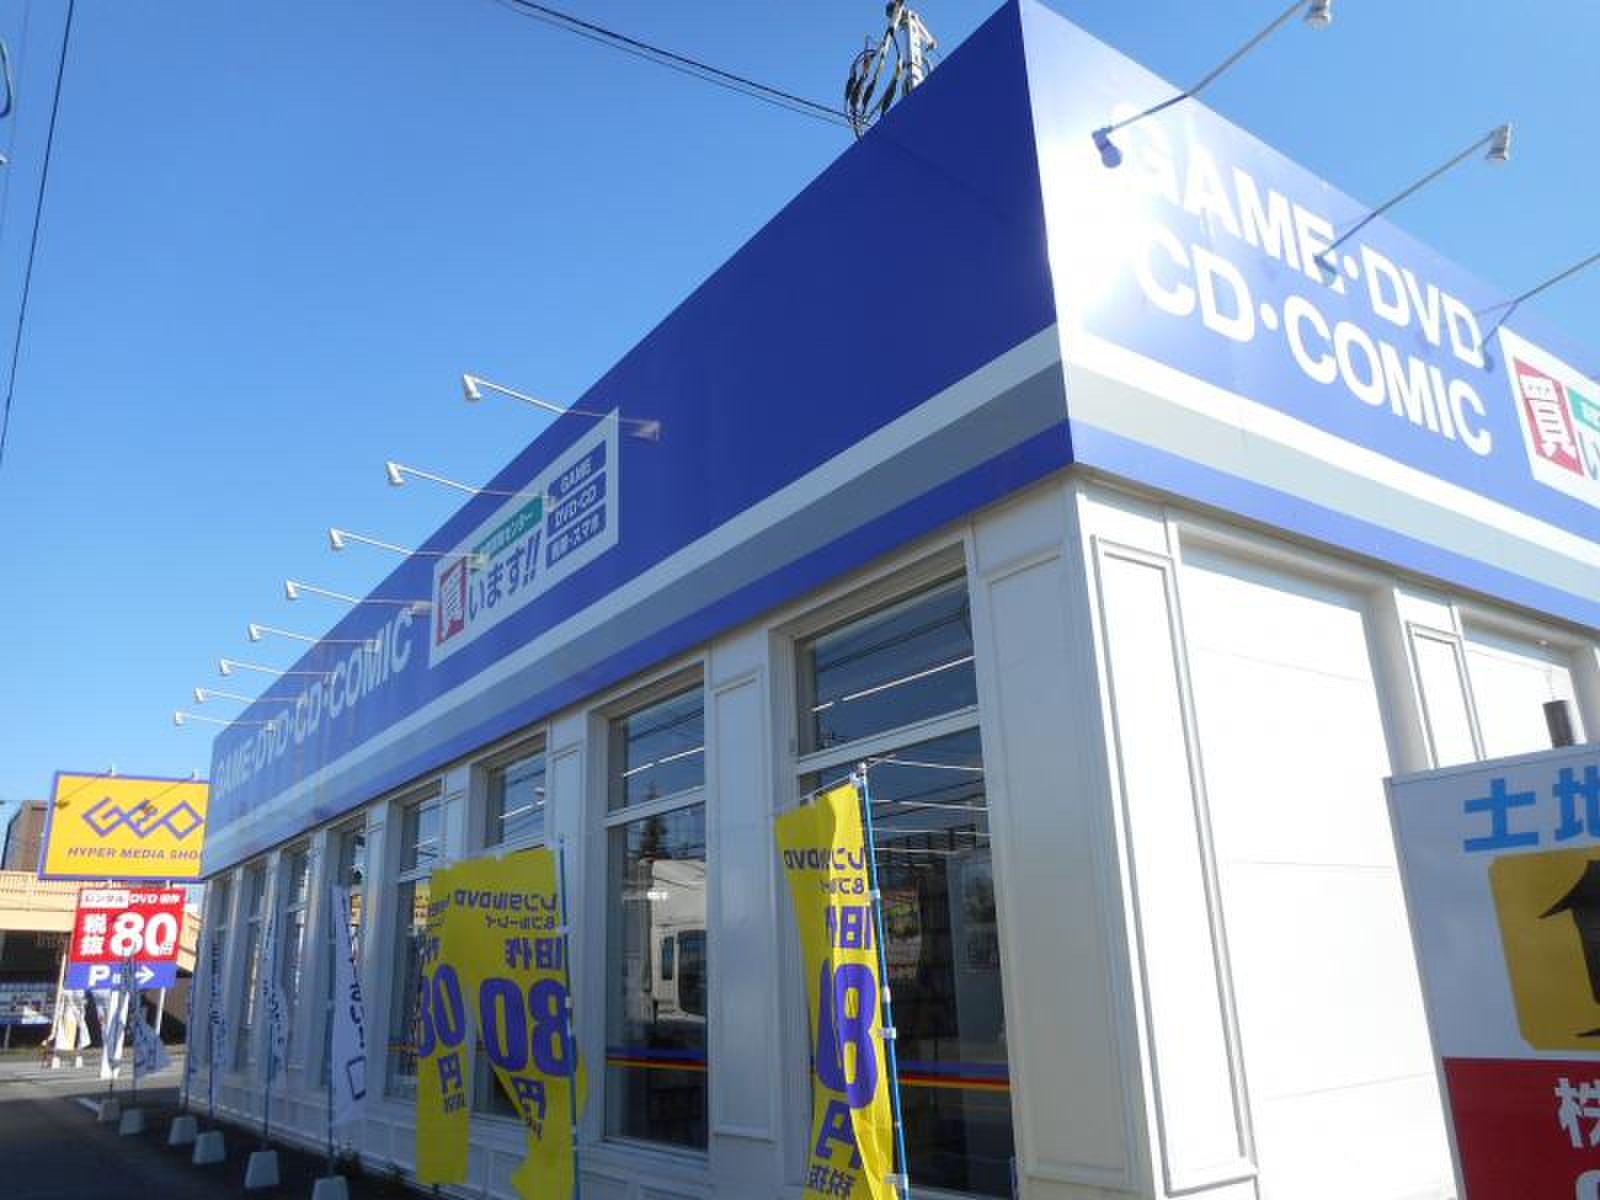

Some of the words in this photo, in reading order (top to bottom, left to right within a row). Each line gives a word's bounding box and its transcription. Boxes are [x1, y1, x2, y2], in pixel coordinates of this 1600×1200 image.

[67, 847, 115, 859] HYPER
[119, 848, 165, 860] MEDIA
[169, 849, 204, 862] SHO
[110, 911, 177, 957] 80
